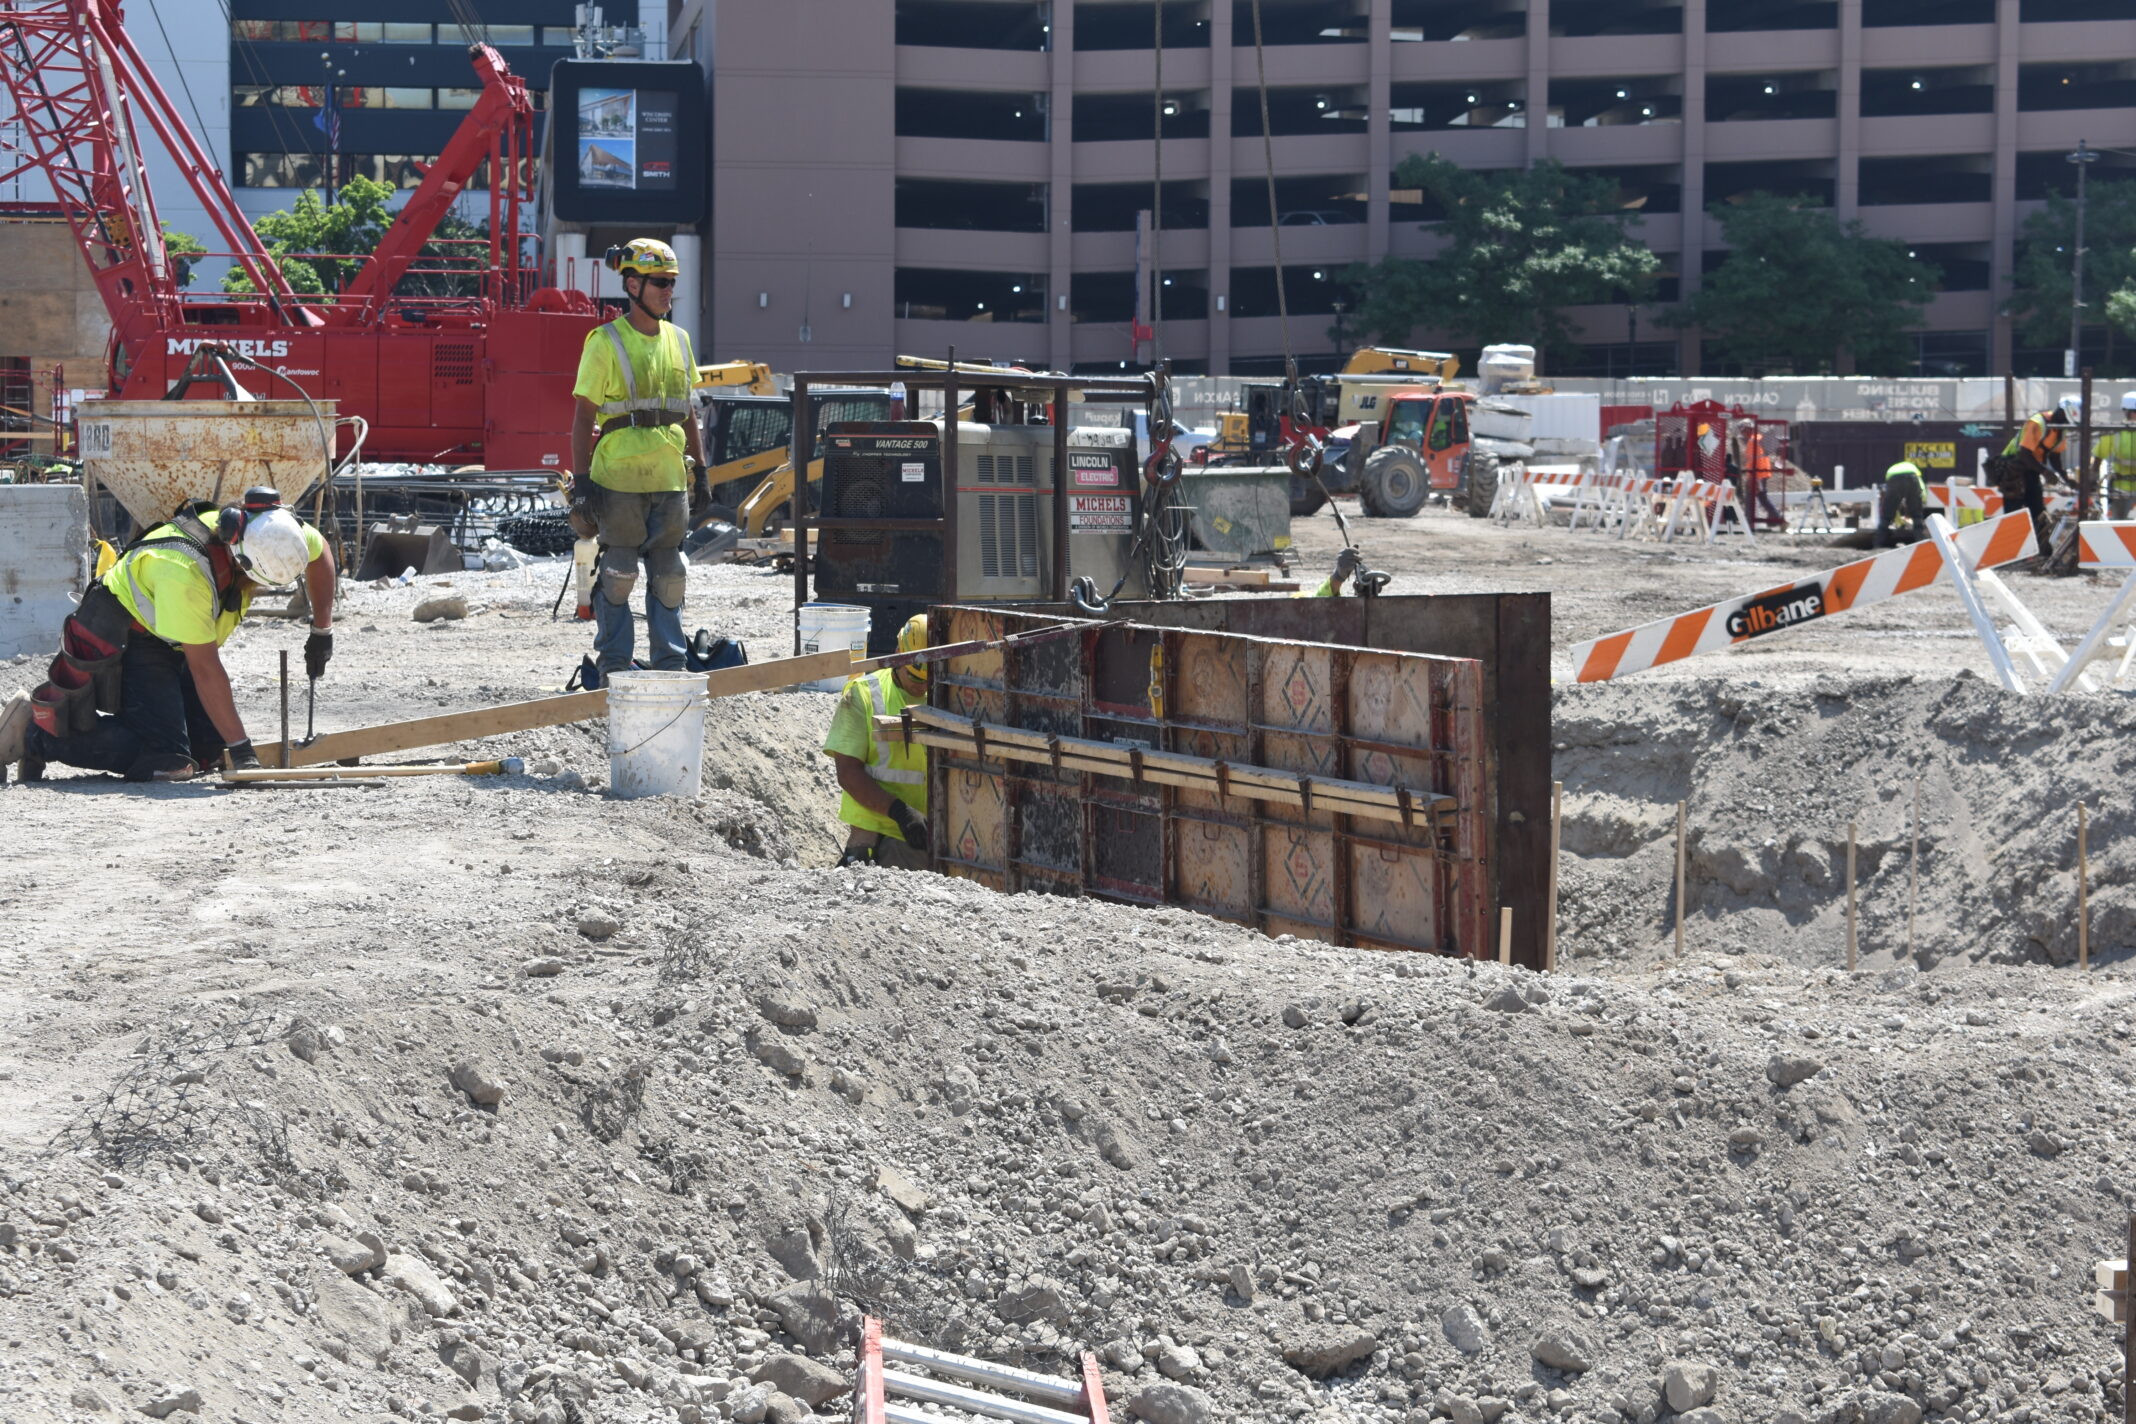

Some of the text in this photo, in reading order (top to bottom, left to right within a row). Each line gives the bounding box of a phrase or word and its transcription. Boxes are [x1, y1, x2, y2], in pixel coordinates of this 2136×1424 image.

[167, 339, 288, 357] MIELS
[1360, 396, 1377, 410] JLG
[876, 440, 928, 449] VANTAGE 500
[1071, 456, 1109, 468] LINCOLN
[1081, 472, 1115, 482] ELECTRIC
[1076, 497, 1126, 511] MICHELS
[1080, 515, 1125, 526] FOUNDATIONS
[1729, 595, 1822, 633] Gilbane
